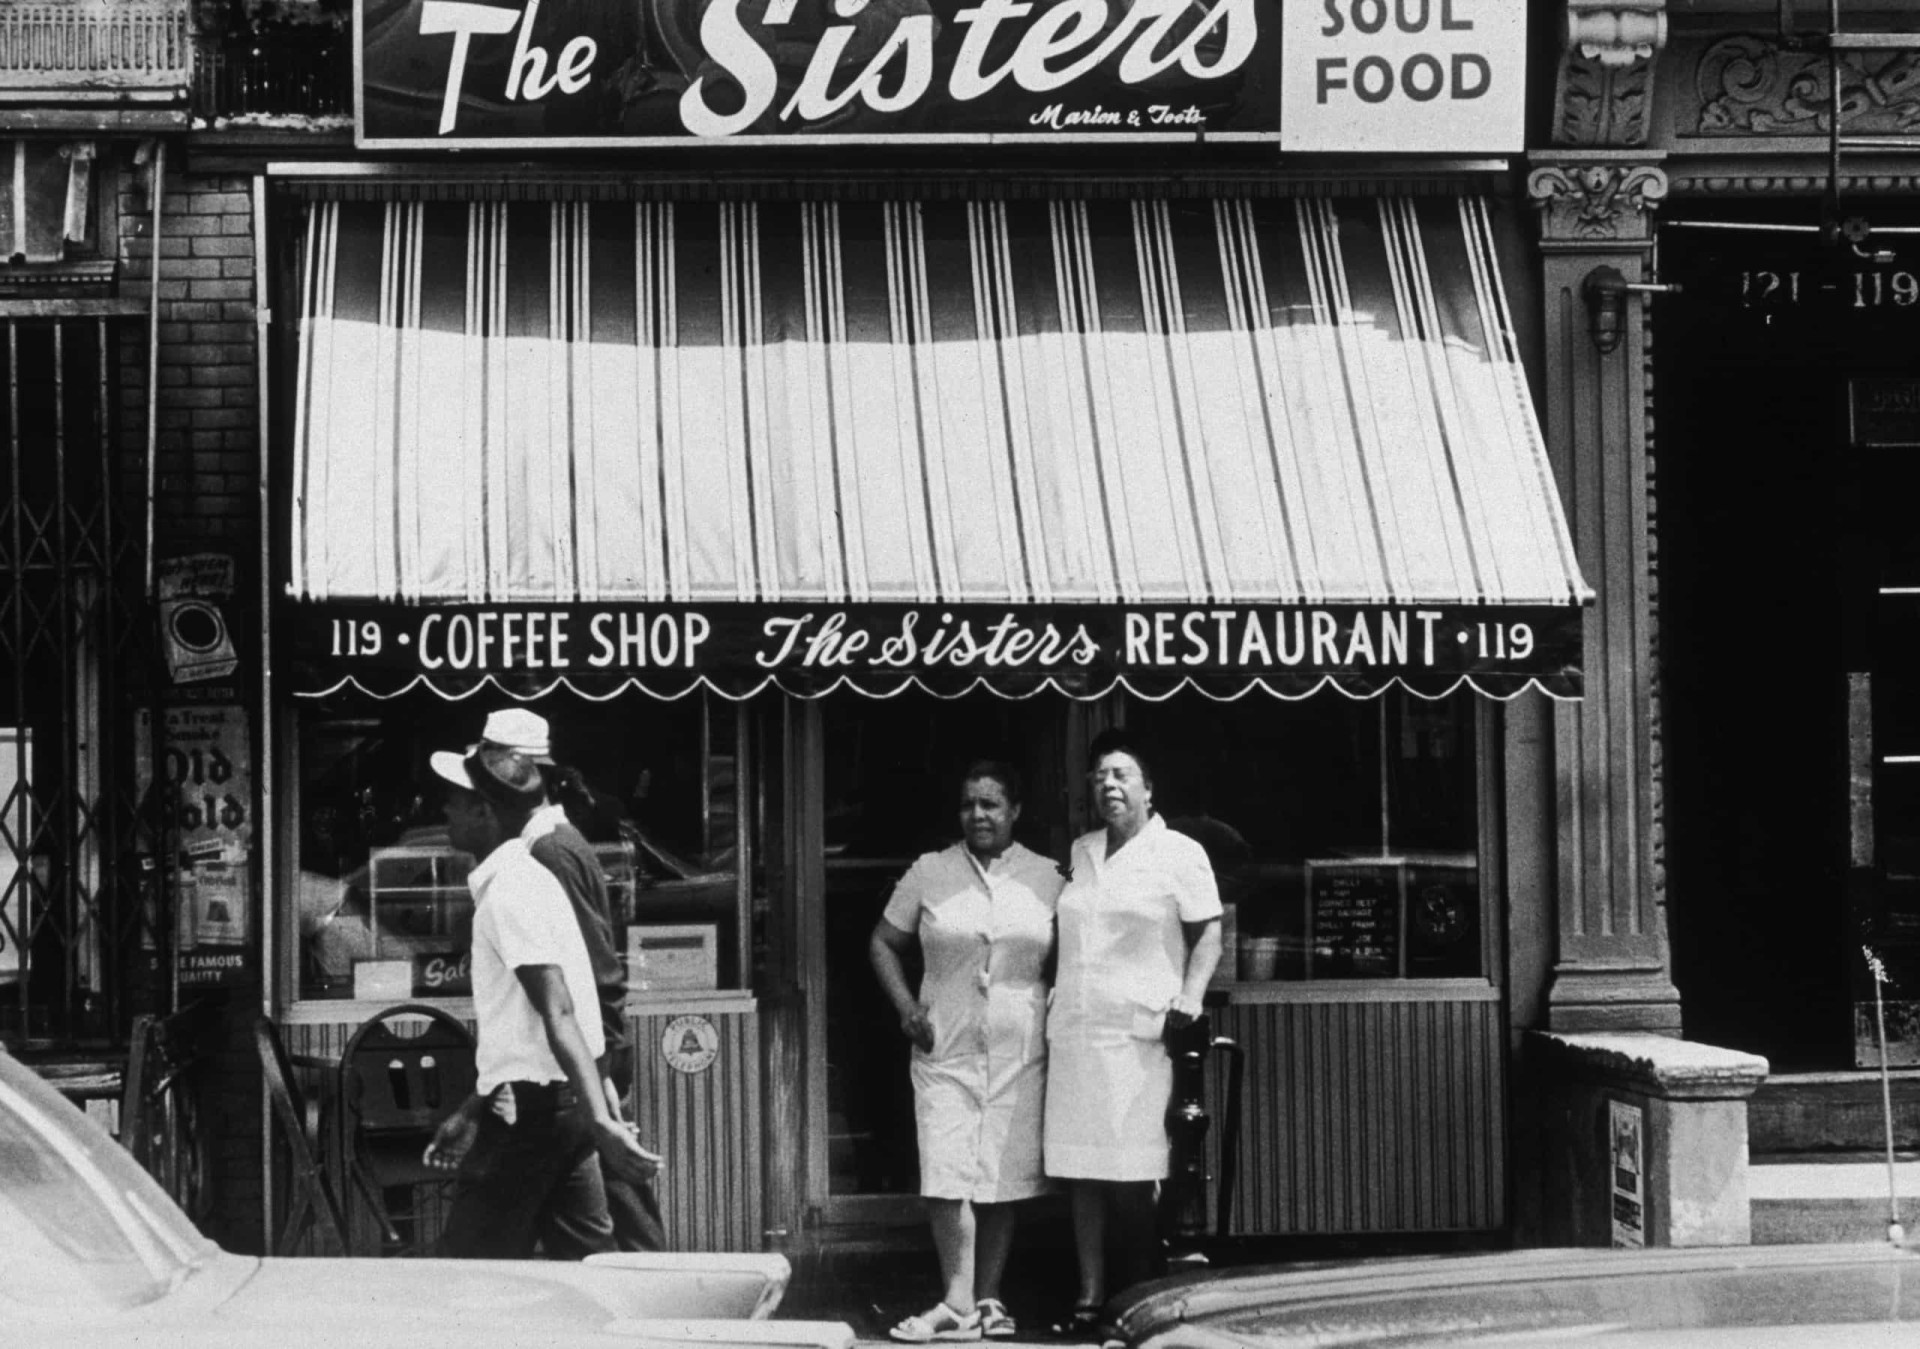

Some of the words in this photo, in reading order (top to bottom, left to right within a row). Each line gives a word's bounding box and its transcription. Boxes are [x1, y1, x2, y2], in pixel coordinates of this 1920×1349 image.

[1321, 0, 1474, 37] SOUL
[418, 0, 598, 135] The
[680, 0, 1258, 137] Sisters
[1315, 53, 1492, 104] FOOD
[1029, 104, 1122, 130] Marion
[1127, 110, 1141, 127] &
[1148, 104, 1207, 127] Toots
[1854, 271, 1919, 307] 119
[331, 620, 383, 656] 119
[418, 612, 570, 669] COFFEE
[587, 612, 711, 668] SHOP
[755, 611, 870, 668] The
[868, 611, 1100, 667] Sisters
[1125, 610, 1443, 666] RESTAURANT
[1475, 622, 1534, 660] 119
[190, 954, 243, 969] FAMOUS
